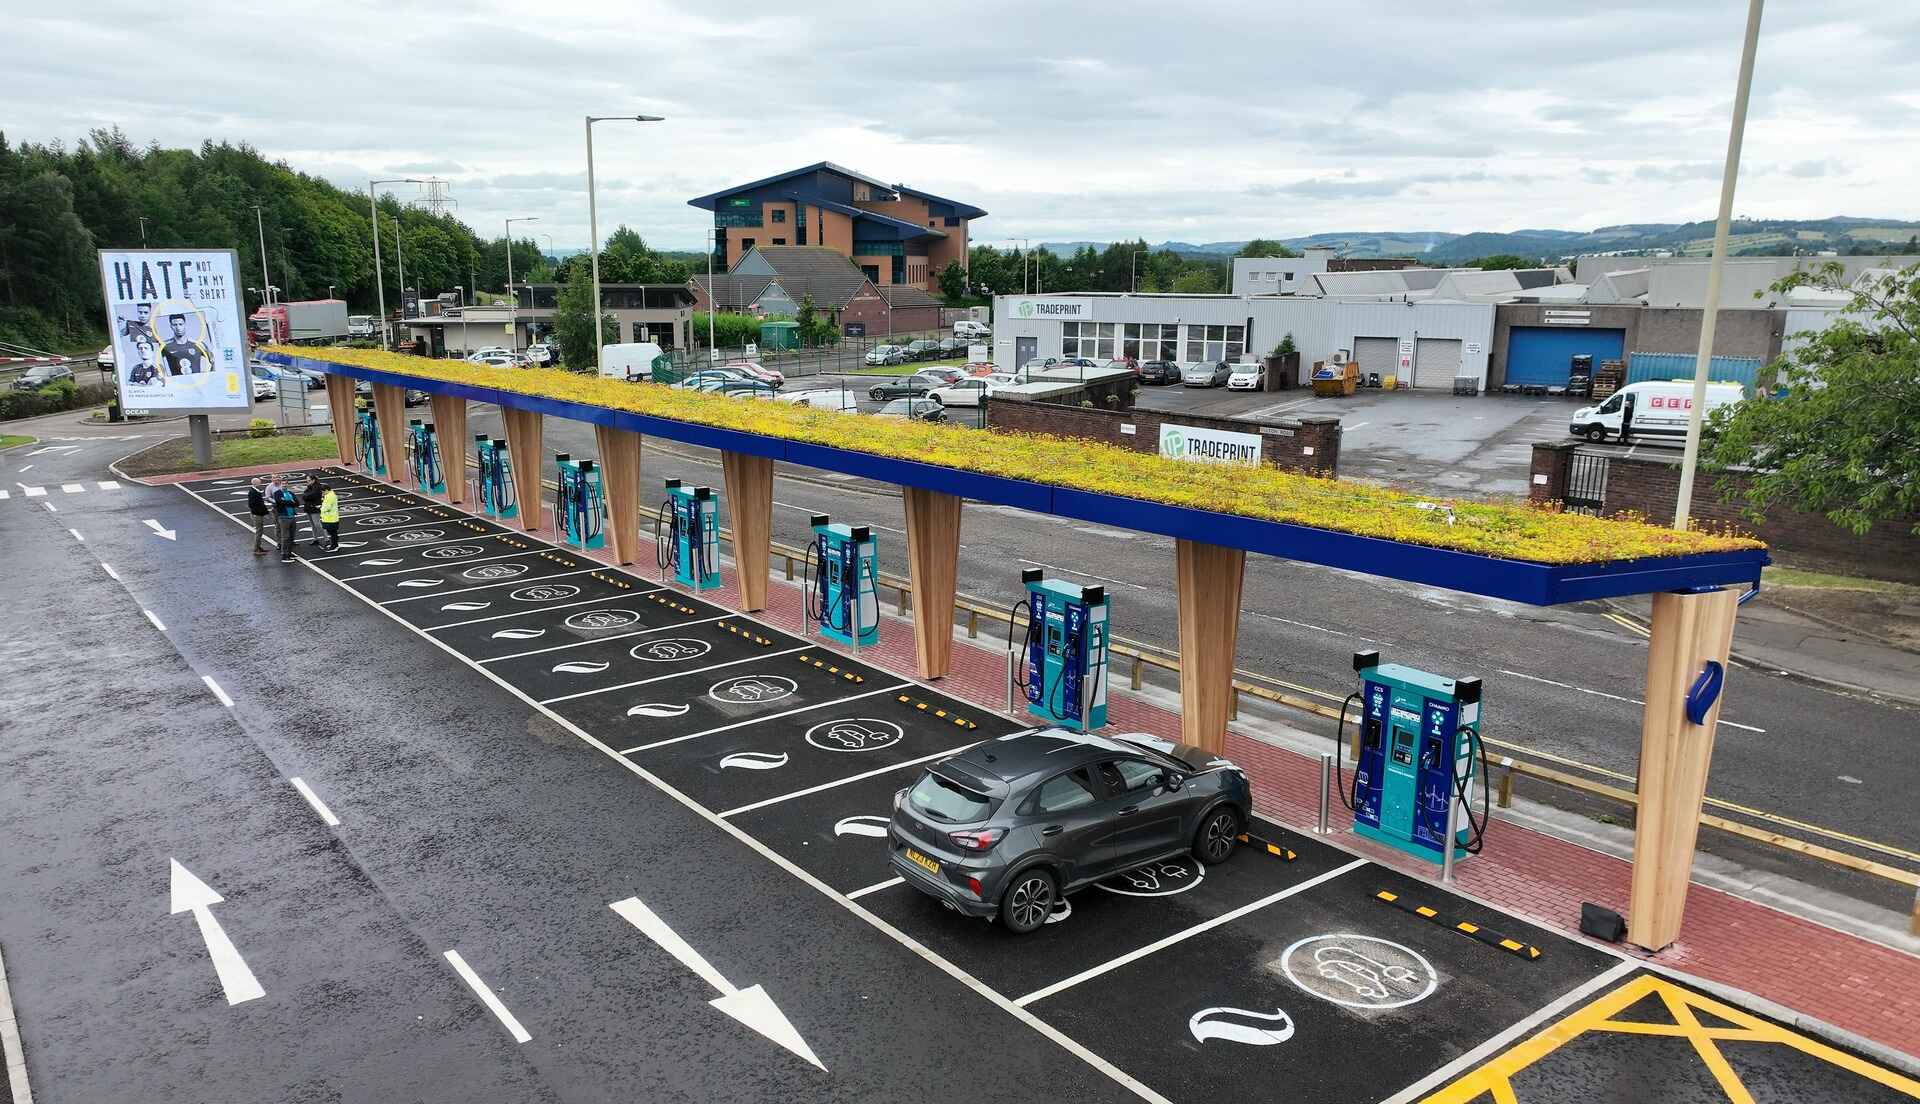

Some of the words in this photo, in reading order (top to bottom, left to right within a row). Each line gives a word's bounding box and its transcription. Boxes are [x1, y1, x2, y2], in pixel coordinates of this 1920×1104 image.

[195, 261, 211, 272] NOT
[199, 275, 209, 286] IN
[213, 275, 224, 286] MY
[200, 288, 226, 300] SHIRT
[1036, 303, 1082, 315] TRADEPRINT
[1188, 438, 1256, 461] TRADEPRINT
